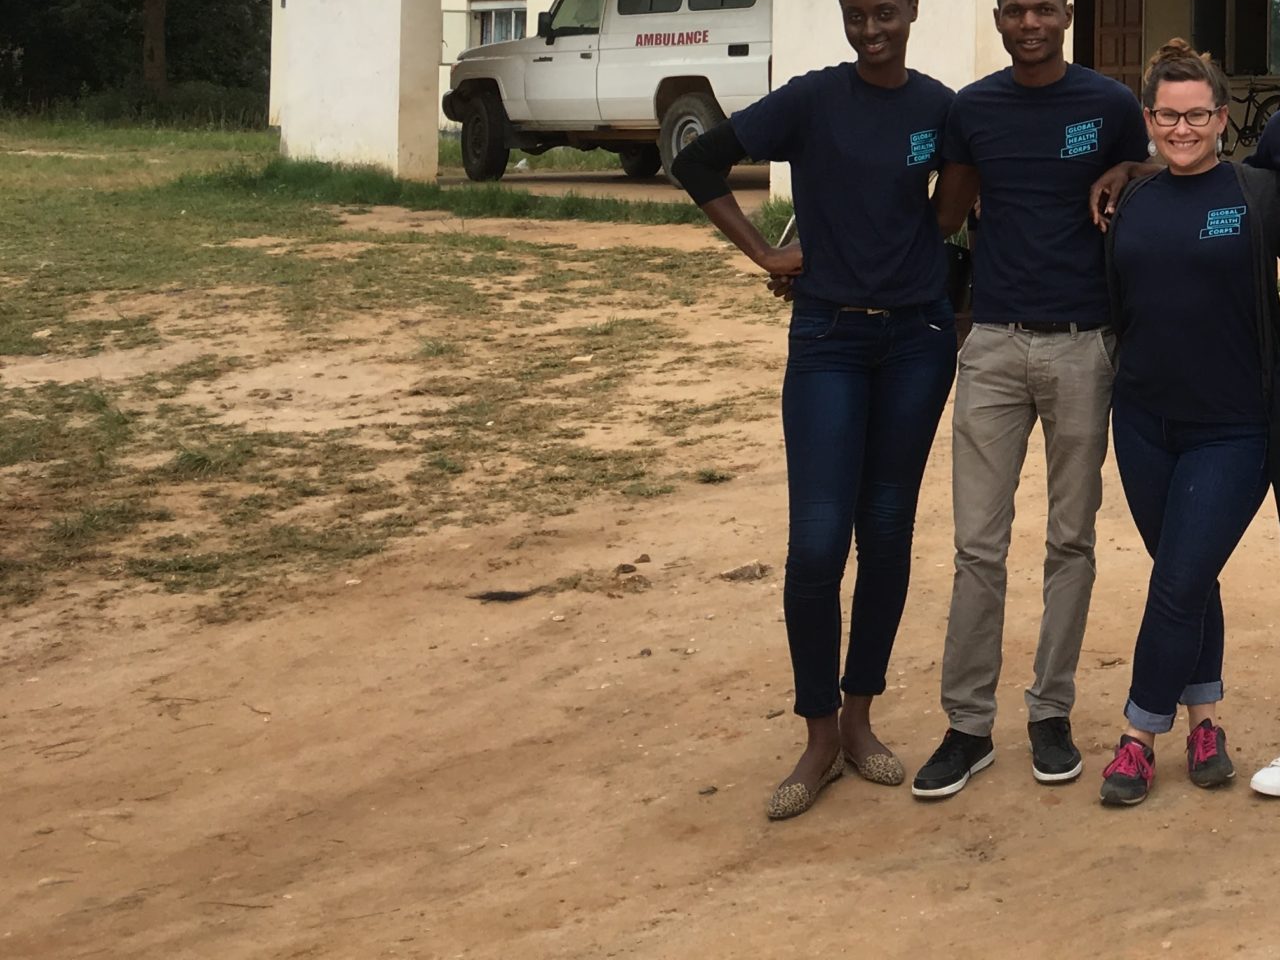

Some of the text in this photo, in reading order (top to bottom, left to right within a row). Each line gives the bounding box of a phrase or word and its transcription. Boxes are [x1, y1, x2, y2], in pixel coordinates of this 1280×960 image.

[635, 29, 709, 47] AMBULANCE
[1068, 122, 1095, 133] GLOBAL
[1068, 133, 1095, 144] HEALTH
[1068, 145, 1091, 155] CORPS
[1210, 209, 1238, 217] GLOBAL
